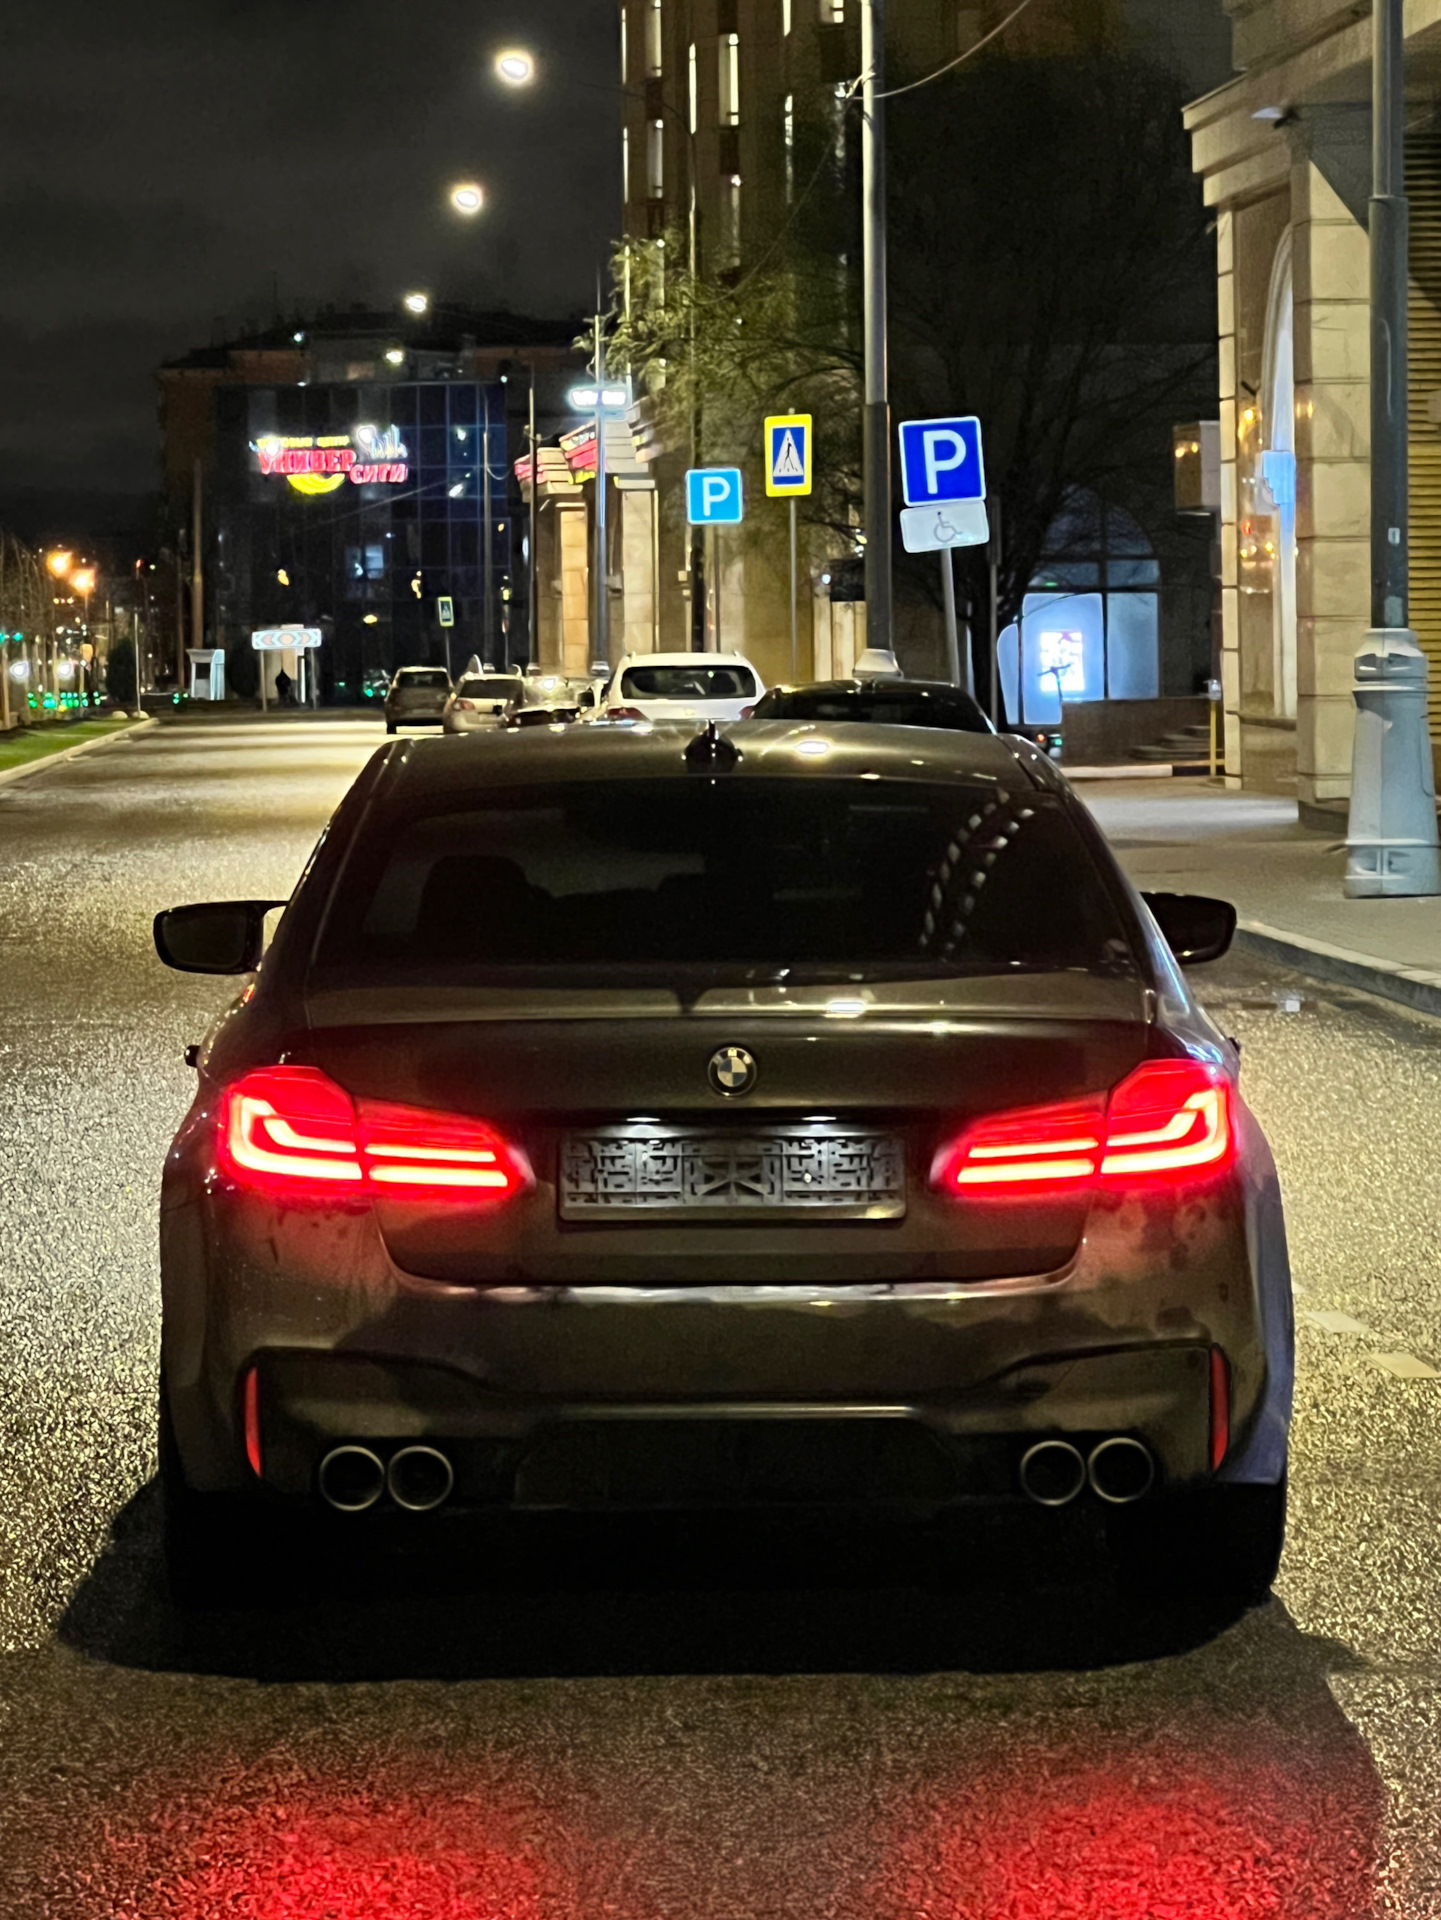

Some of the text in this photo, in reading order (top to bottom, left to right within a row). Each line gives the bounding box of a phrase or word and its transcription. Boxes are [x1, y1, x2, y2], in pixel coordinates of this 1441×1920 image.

[258, 449, 357, 474] УНИВЕР
[922, 429, 967, 495] P
[702, 476, 731, 517] P
